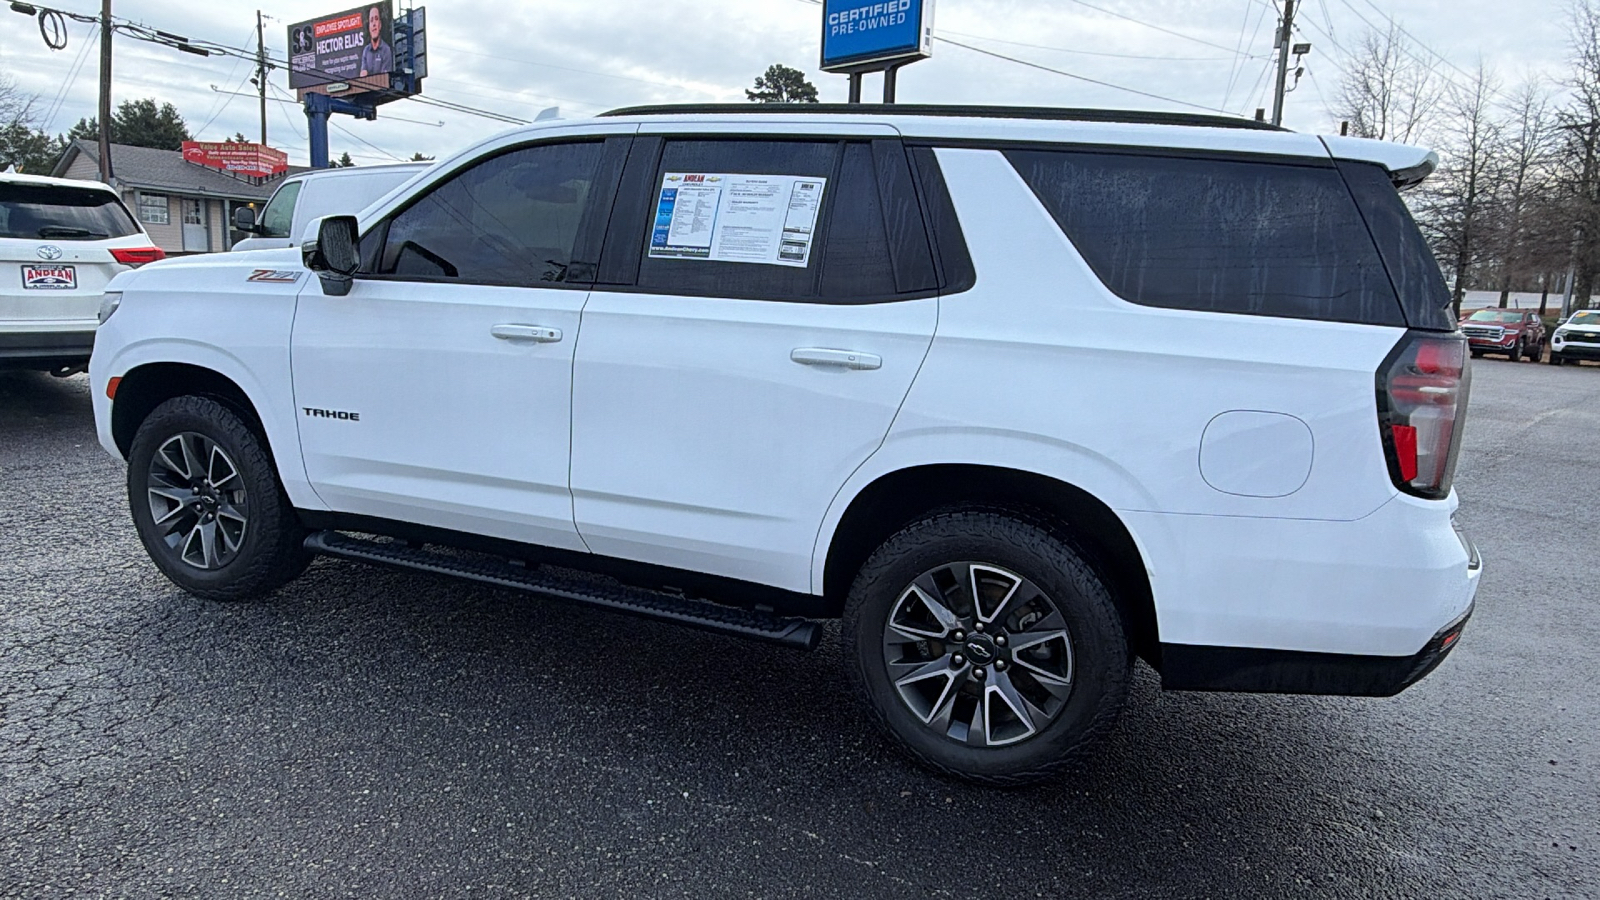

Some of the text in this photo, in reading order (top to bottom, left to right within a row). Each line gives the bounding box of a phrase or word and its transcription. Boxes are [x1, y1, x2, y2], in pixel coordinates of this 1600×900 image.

[828, 0, 910, 25] CERTIFIED
[832, 12, 906, 36] PRE-OWNED
[316, 16, 360, 34] EMPLOYEE SPOTLIGHT
[293, 26, 312, 54] S&S
[316, 32, 364, 55] HECTOR ELIAS
[28, 269, 72, 282] ANDEAN
[302, 407, 360, 421] TAHOE
